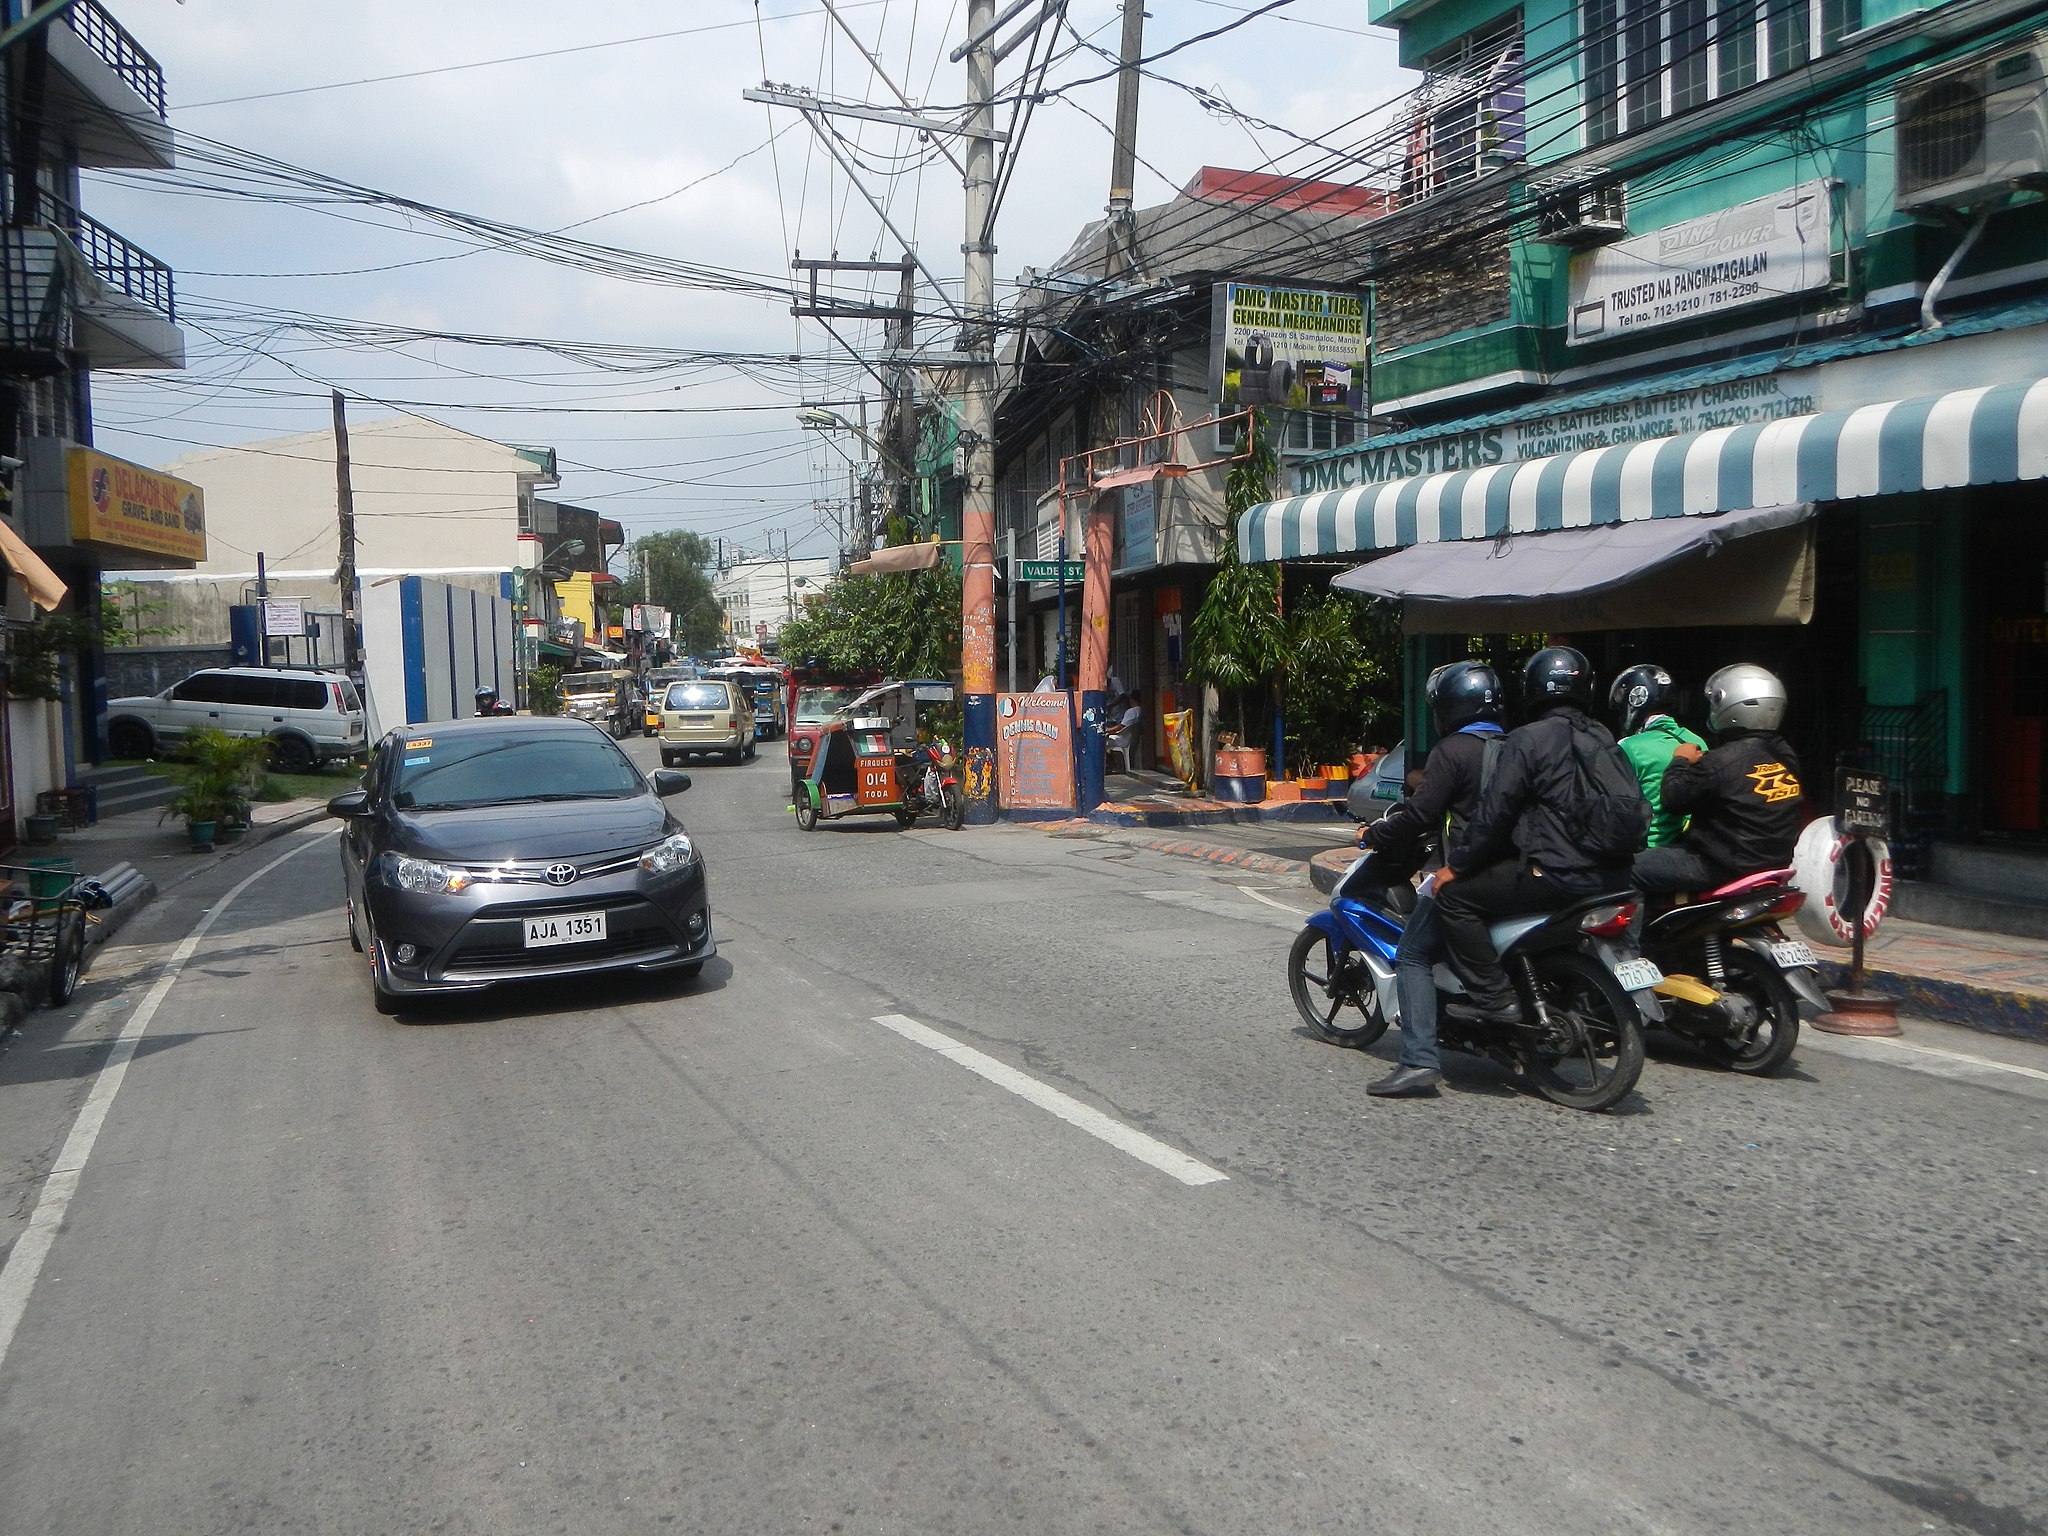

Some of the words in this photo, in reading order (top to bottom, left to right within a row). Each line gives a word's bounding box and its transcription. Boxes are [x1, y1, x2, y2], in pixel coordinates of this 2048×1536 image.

[1662, 223, 1718, 252] DYNA
[1705, 222, 1773, 258] POWER
[1610, 282, 1655, 312] TRUSTED
[1657, 278, 1672, 299] NA
[1674, 251, 1768, 295] PANGMATAGALAN
[1234, 287, 1266, 308] DMC
[1269, 289, 1324, 314] MASTER
[1325, 295, 1364, 317] TIRES
[1618, 314, 1633, 327] Tel
[1635, 311, 1651, 323] no.
[1653, 296, 1700, 319] 712-1210
[1708, 281, 1759, 305] 781-2290
[1233, 308, 1281, 328] GENERAL
[1283, 312, 1362, 334] MERCHANDISE
[1262, 329, 1288, 340] Tuazon
[1338, 336, 1361, 345] Manila
[1515, 419, 1557, 441] TIRES,
[1558, 404, 1634, 434] BATTERIES,
[1634, 392, 1698, 420] BATTERY
[1701, 376, 1779, 407] CHARGING
[1697, 405, 1752, 432] 7812290
[1300, 458, 1355, 495] DMC
[1360, 429, 1504, 485] MASTERS
[122, 499, 149, 522] GRAVEL
[150, 508, 164, 525] AND
[164, 510, 181, 529] SAND
[1027, 566, 1065, 576] VALDE
[1068, 566, 1083, 576] ST.
[1017, 696, 1068, 709] Welcome!
[860, 759, 893, 767] FIRQUEST
[866, 772, 888, 786] 014
[1845, 776, 1881, 796] PLEASE
[865, 790, 888, 799] TODA
[1856, 796, 1870, 807] NO
[530, 922, 558, 941] AJA
[565, 917, 601, 936] 1351
[1620, 969, 1645, 988] 7767
